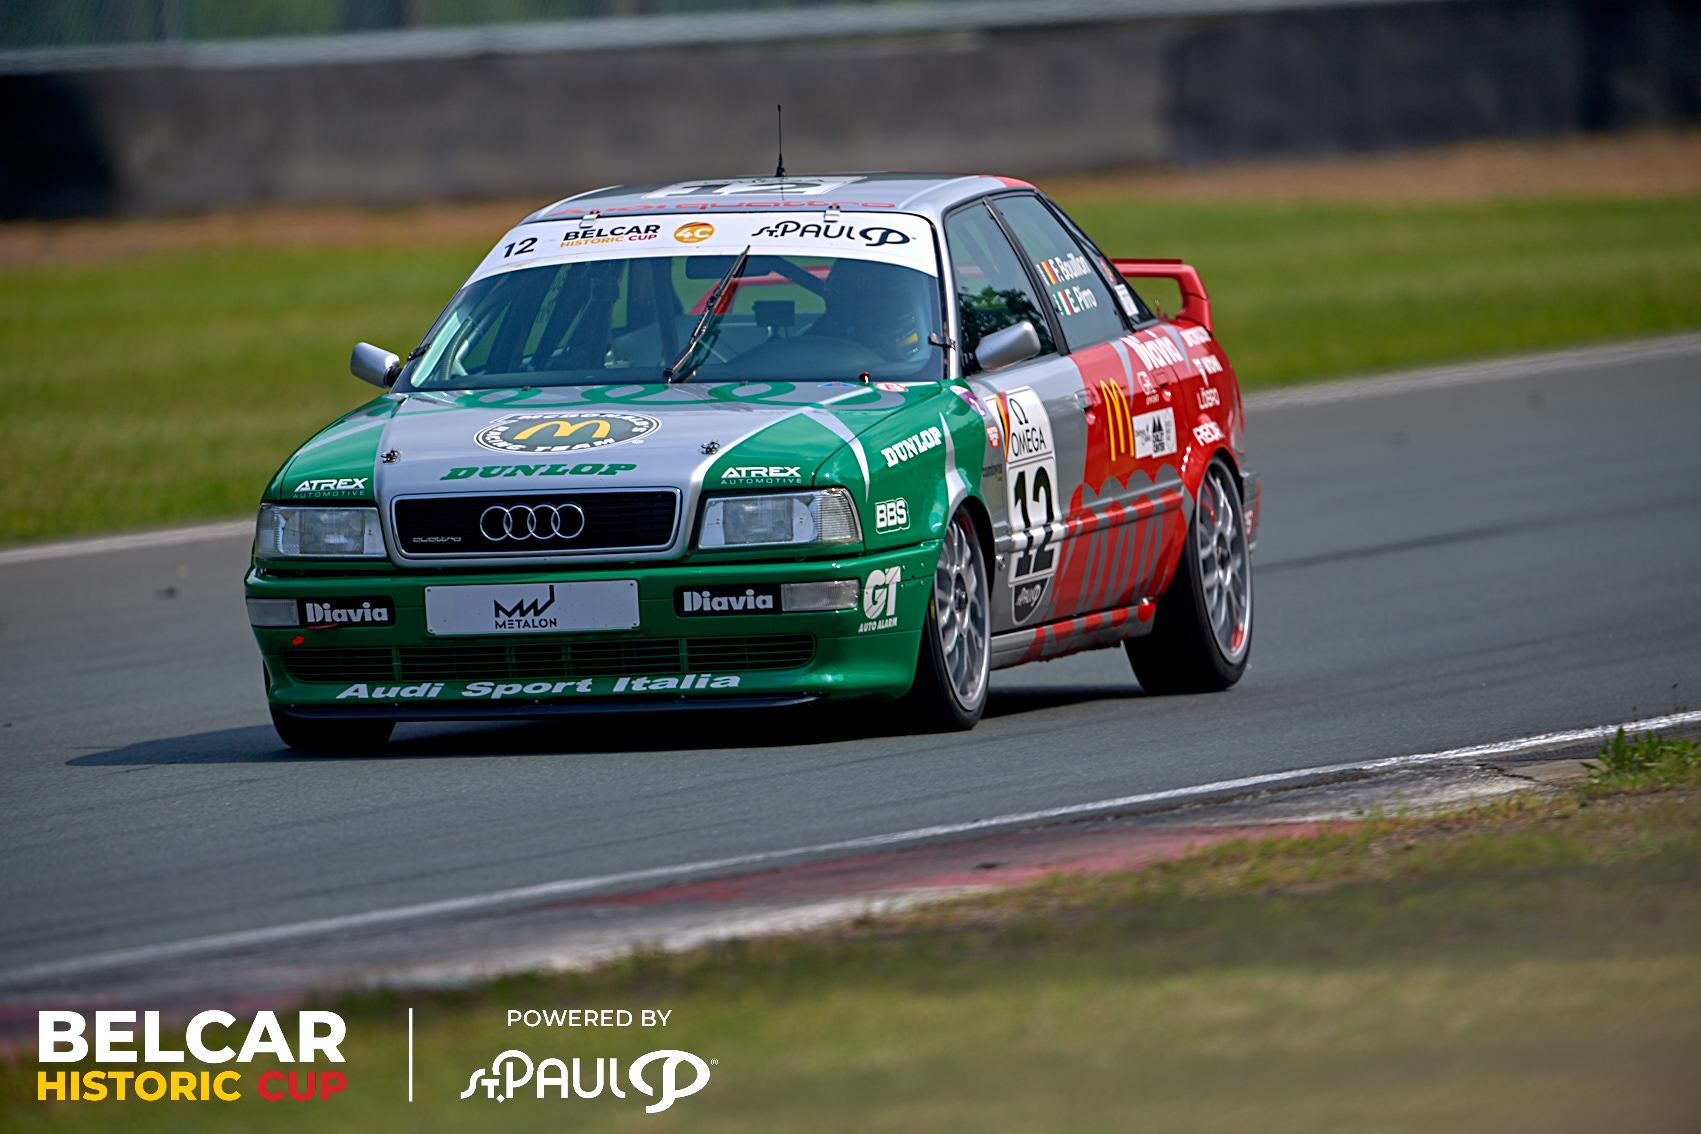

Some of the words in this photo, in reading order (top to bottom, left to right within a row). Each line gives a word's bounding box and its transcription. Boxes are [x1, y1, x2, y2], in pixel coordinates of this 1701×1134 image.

[665, 183, 822, 196] 12
[560, 236, 624, 248] HISTORIC
[628, 234, 658, 242] CUP
[563, 225, 661, 241] BELCAR
[675, 227, 713, 240] 4C
[504, 237, 538, 259] 12
[485, 426, 527, 451] RACING
[534, 438, 616, 452] TEAM
[881, 426, 942, 468] DUNLOP
[1011, 427, 1046, 457] OMEGA
[440, 463, 637, 481] DUNLOP
[720, 466, 801, 478] ATREX
[294, 478, 368, 493] ATREX
[720, 477, 802, 485] AUTOMOTIVE
[292, 489, 365, 499] AUTOMOTIVE
[875, 498, 910, 532] BBS
[1014, 466, 1054, 577] 12
[683, 589, 774, 612] Diavia
[863, 565, 901, 619] GT
[305, 602, 388, 624] Diavia
[495, 617, 557, 630] METALON
[858, 622, 877, 633] AUTO
[877, 617, 898, 631] ALARM
[336, 683, 445, 700] Audi
[461, 678, 593, 700] Sport
[613, 674, 741, 693] Italia
